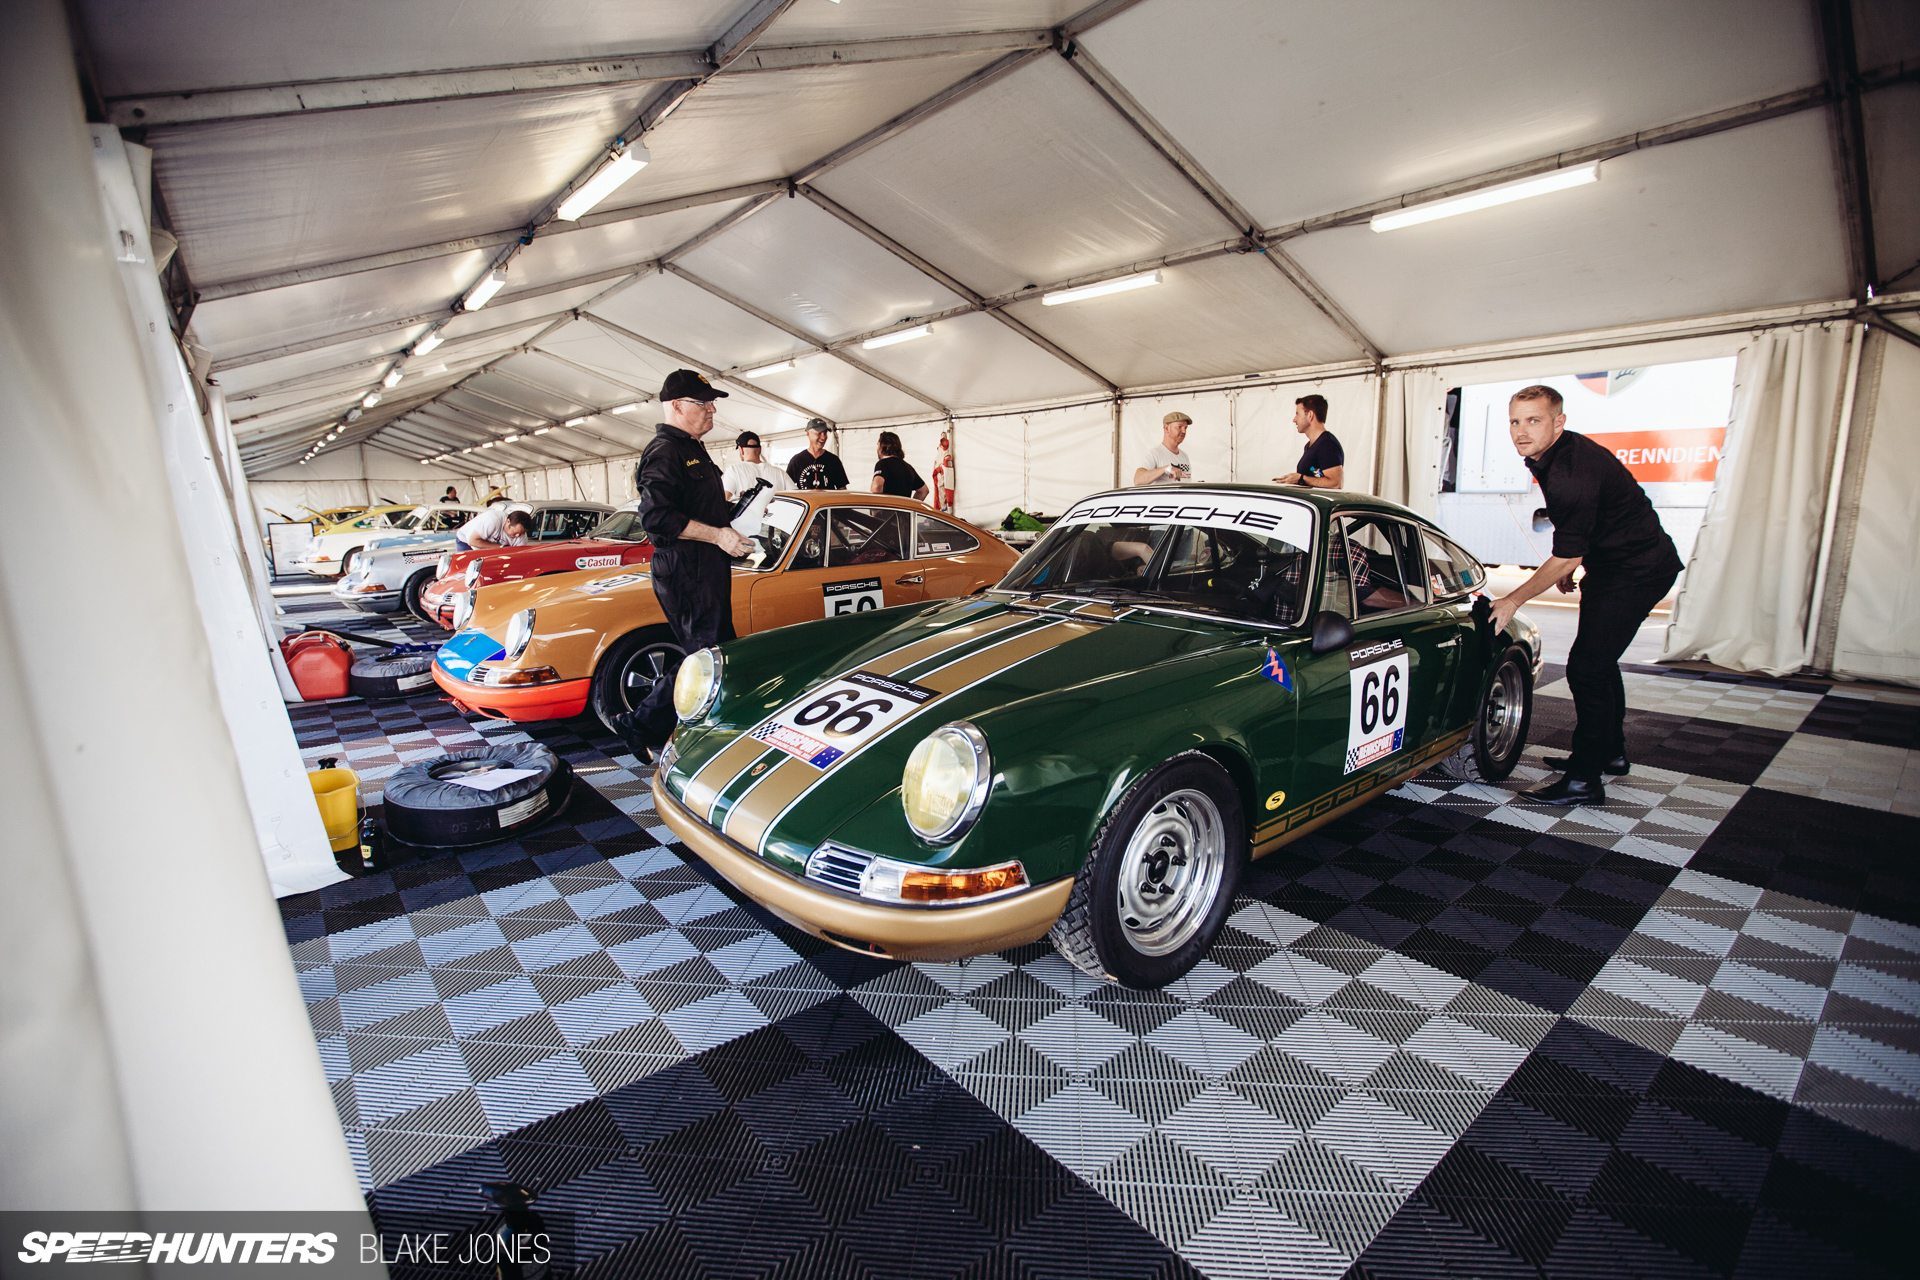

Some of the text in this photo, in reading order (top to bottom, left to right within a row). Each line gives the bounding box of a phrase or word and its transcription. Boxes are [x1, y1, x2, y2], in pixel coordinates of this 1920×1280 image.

[1066, 505, 1283, 531] PORSCHE
[587, 557, 618, 568] Castrol
[826, 580, 879, 592] PORSCHE
[1350, 638, 1404, 661] PORSCHE
[851, 673, 930, 700] PORSCHE
[1360, 664, 1400, 735] 66
[793, 689, 894, 739] 66
[771, 726, 828, 756] RENNSPORT
[1357, 734, 1394, 761] RENNSPORT
[1287, 752, 1428, 830] PORSCHE
